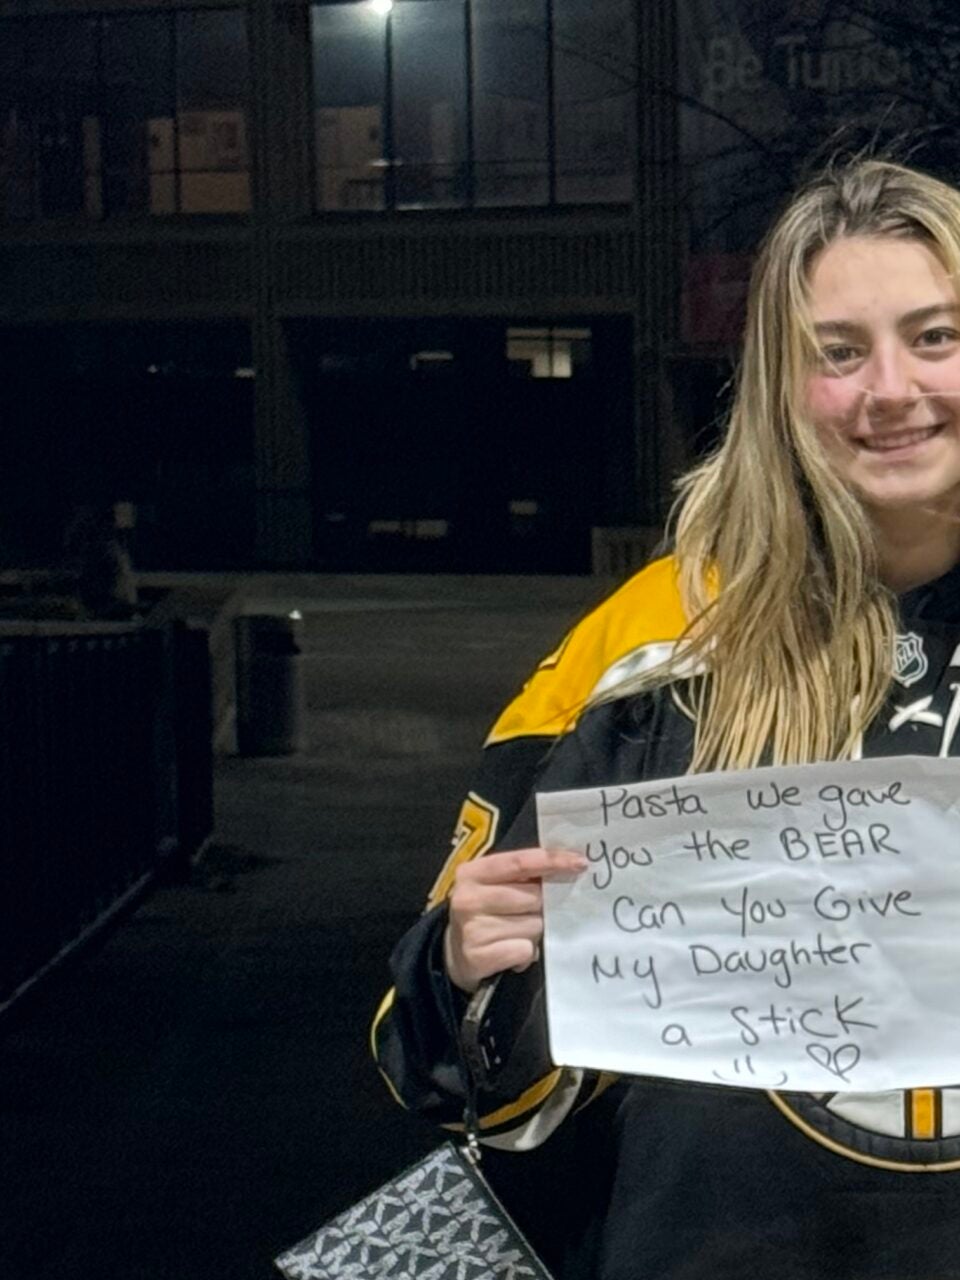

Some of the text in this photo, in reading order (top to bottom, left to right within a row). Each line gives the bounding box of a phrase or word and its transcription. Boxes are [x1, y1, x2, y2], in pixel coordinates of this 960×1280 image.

[818, 780, 912, 831] gave
[683, 830, 750, 861] the
[779, 823, 901, 861] BEAR
[612, 896, 686, 932] Can
[721, 887, 787, 938] You
[591, 934, 872, 1009] My Daughter
[661, 1023, 693, 1047] a
